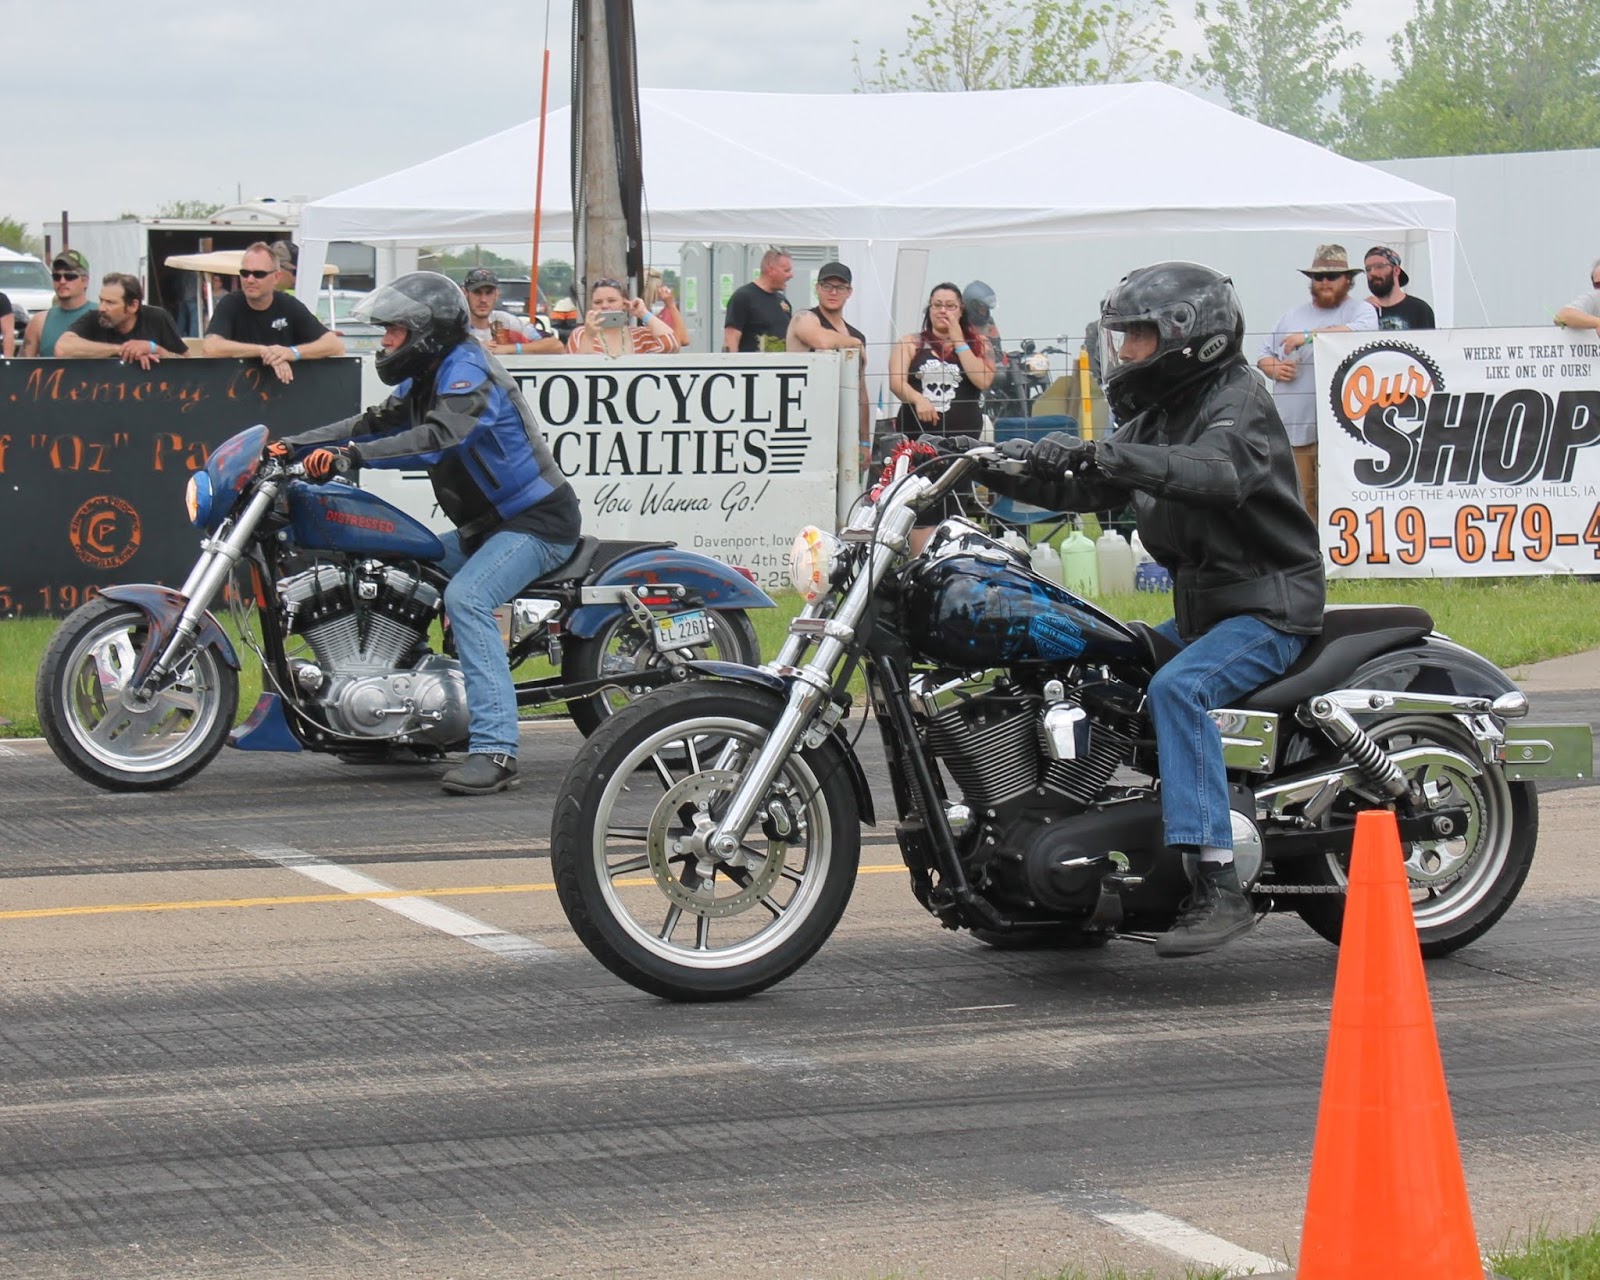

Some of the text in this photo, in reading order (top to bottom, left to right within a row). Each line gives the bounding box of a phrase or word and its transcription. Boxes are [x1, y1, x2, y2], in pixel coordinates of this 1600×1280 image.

[1203, 339, 1224, 358] BELL
[1463, 344, 1600, 361] WHERE WE TREAT YOUR
[1485, 363, 1592, 380] LIKE ONE OF OURS!
[1343, 365, 1434, 421] Our
[1353, 388, 1600, 488] SHOP
[541, 429, 768, 477] CIALTIES
[593, 479, 771, 522] You Wanna Go!
[1351, 485, 1597, 502] SOUTH OF THE 4-WAY STOP IN HILLS, IA
[325, 510, 397, 534] DISTRESSED
[693, 535, 770, 549] Davenport,
[1329, 502, 1600, 566] 319-679-4
[751, 553, 777, 567] 4th
[660, 628, 677, 642] EL
[679, 619, 706, 638] 2261
